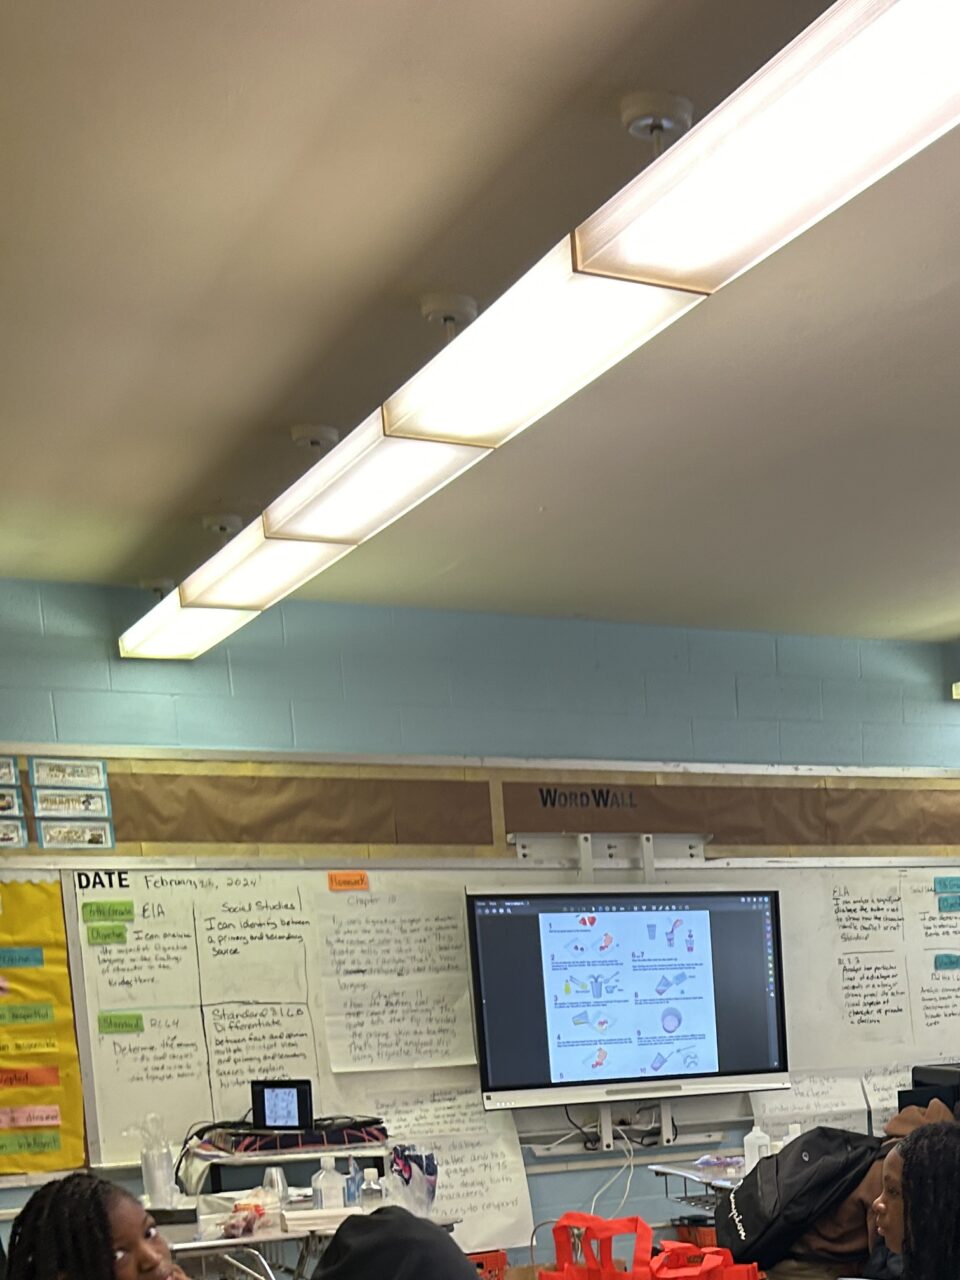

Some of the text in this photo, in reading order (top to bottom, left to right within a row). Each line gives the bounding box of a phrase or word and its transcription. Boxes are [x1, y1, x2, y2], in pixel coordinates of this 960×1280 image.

[77, 871, 130, 889] DATE
[144, 874, 198, 889] February
[221, 900, 295, 913] Social Studies
[204, 917, 216, 931] I
[217, 921, 236, 930] can
[212, 1008, 268, 1021] Standard
[213, 1019, 281, 1033] Differentiate
